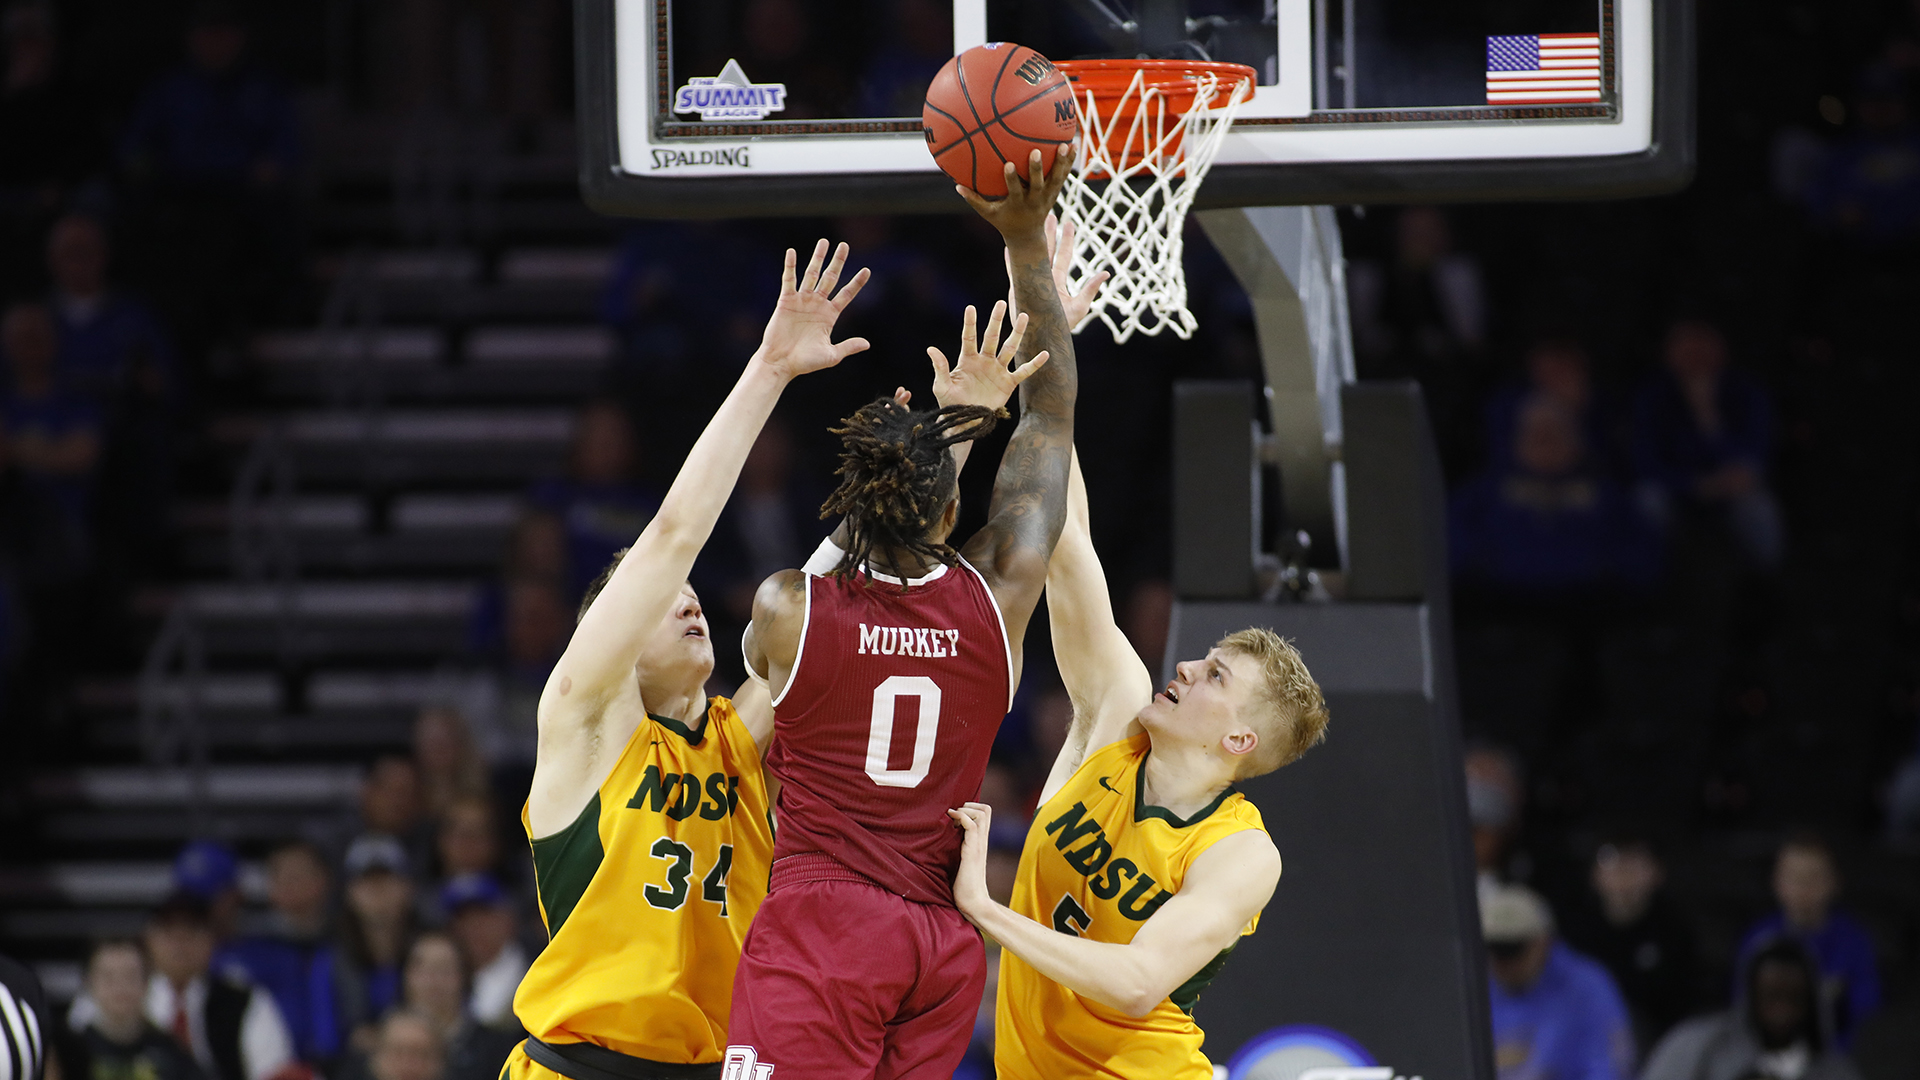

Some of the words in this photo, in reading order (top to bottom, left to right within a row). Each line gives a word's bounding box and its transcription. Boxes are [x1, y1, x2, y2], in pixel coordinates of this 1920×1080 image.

[680, 87, 780, 108] SUMMIT
[1054, 97, 1076, 123] NC
[704, 109, 759, 117] LEAGUE
[651, 146, 751, 170] SPALDING
[858, 623, 959, 658] MURKEY
[864, 675, 942, 788] 0
[1045, 801, 1174, 921] NDSU
[642, 836, 734, 918] 34
